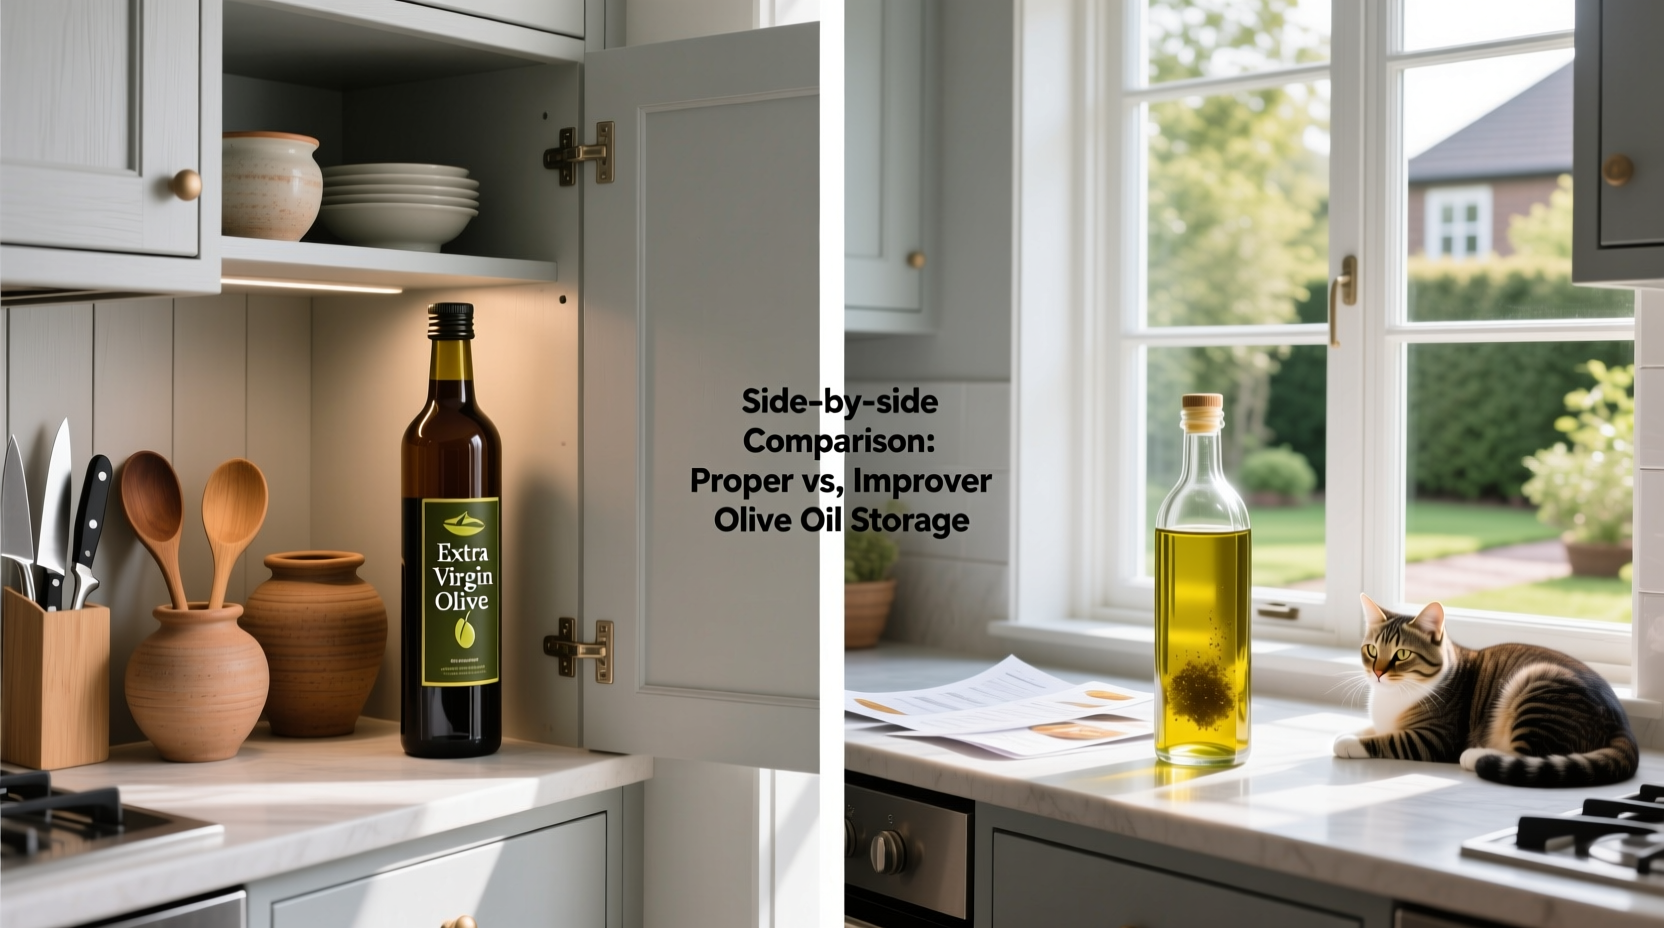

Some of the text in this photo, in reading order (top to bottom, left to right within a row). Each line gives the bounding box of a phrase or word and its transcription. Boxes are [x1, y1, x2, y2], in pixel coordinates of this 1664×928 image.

[437, 543, 489, 562] Extra
[432, 566, 494, 592] Virgin
[435, 591, 489, 611] Olive
